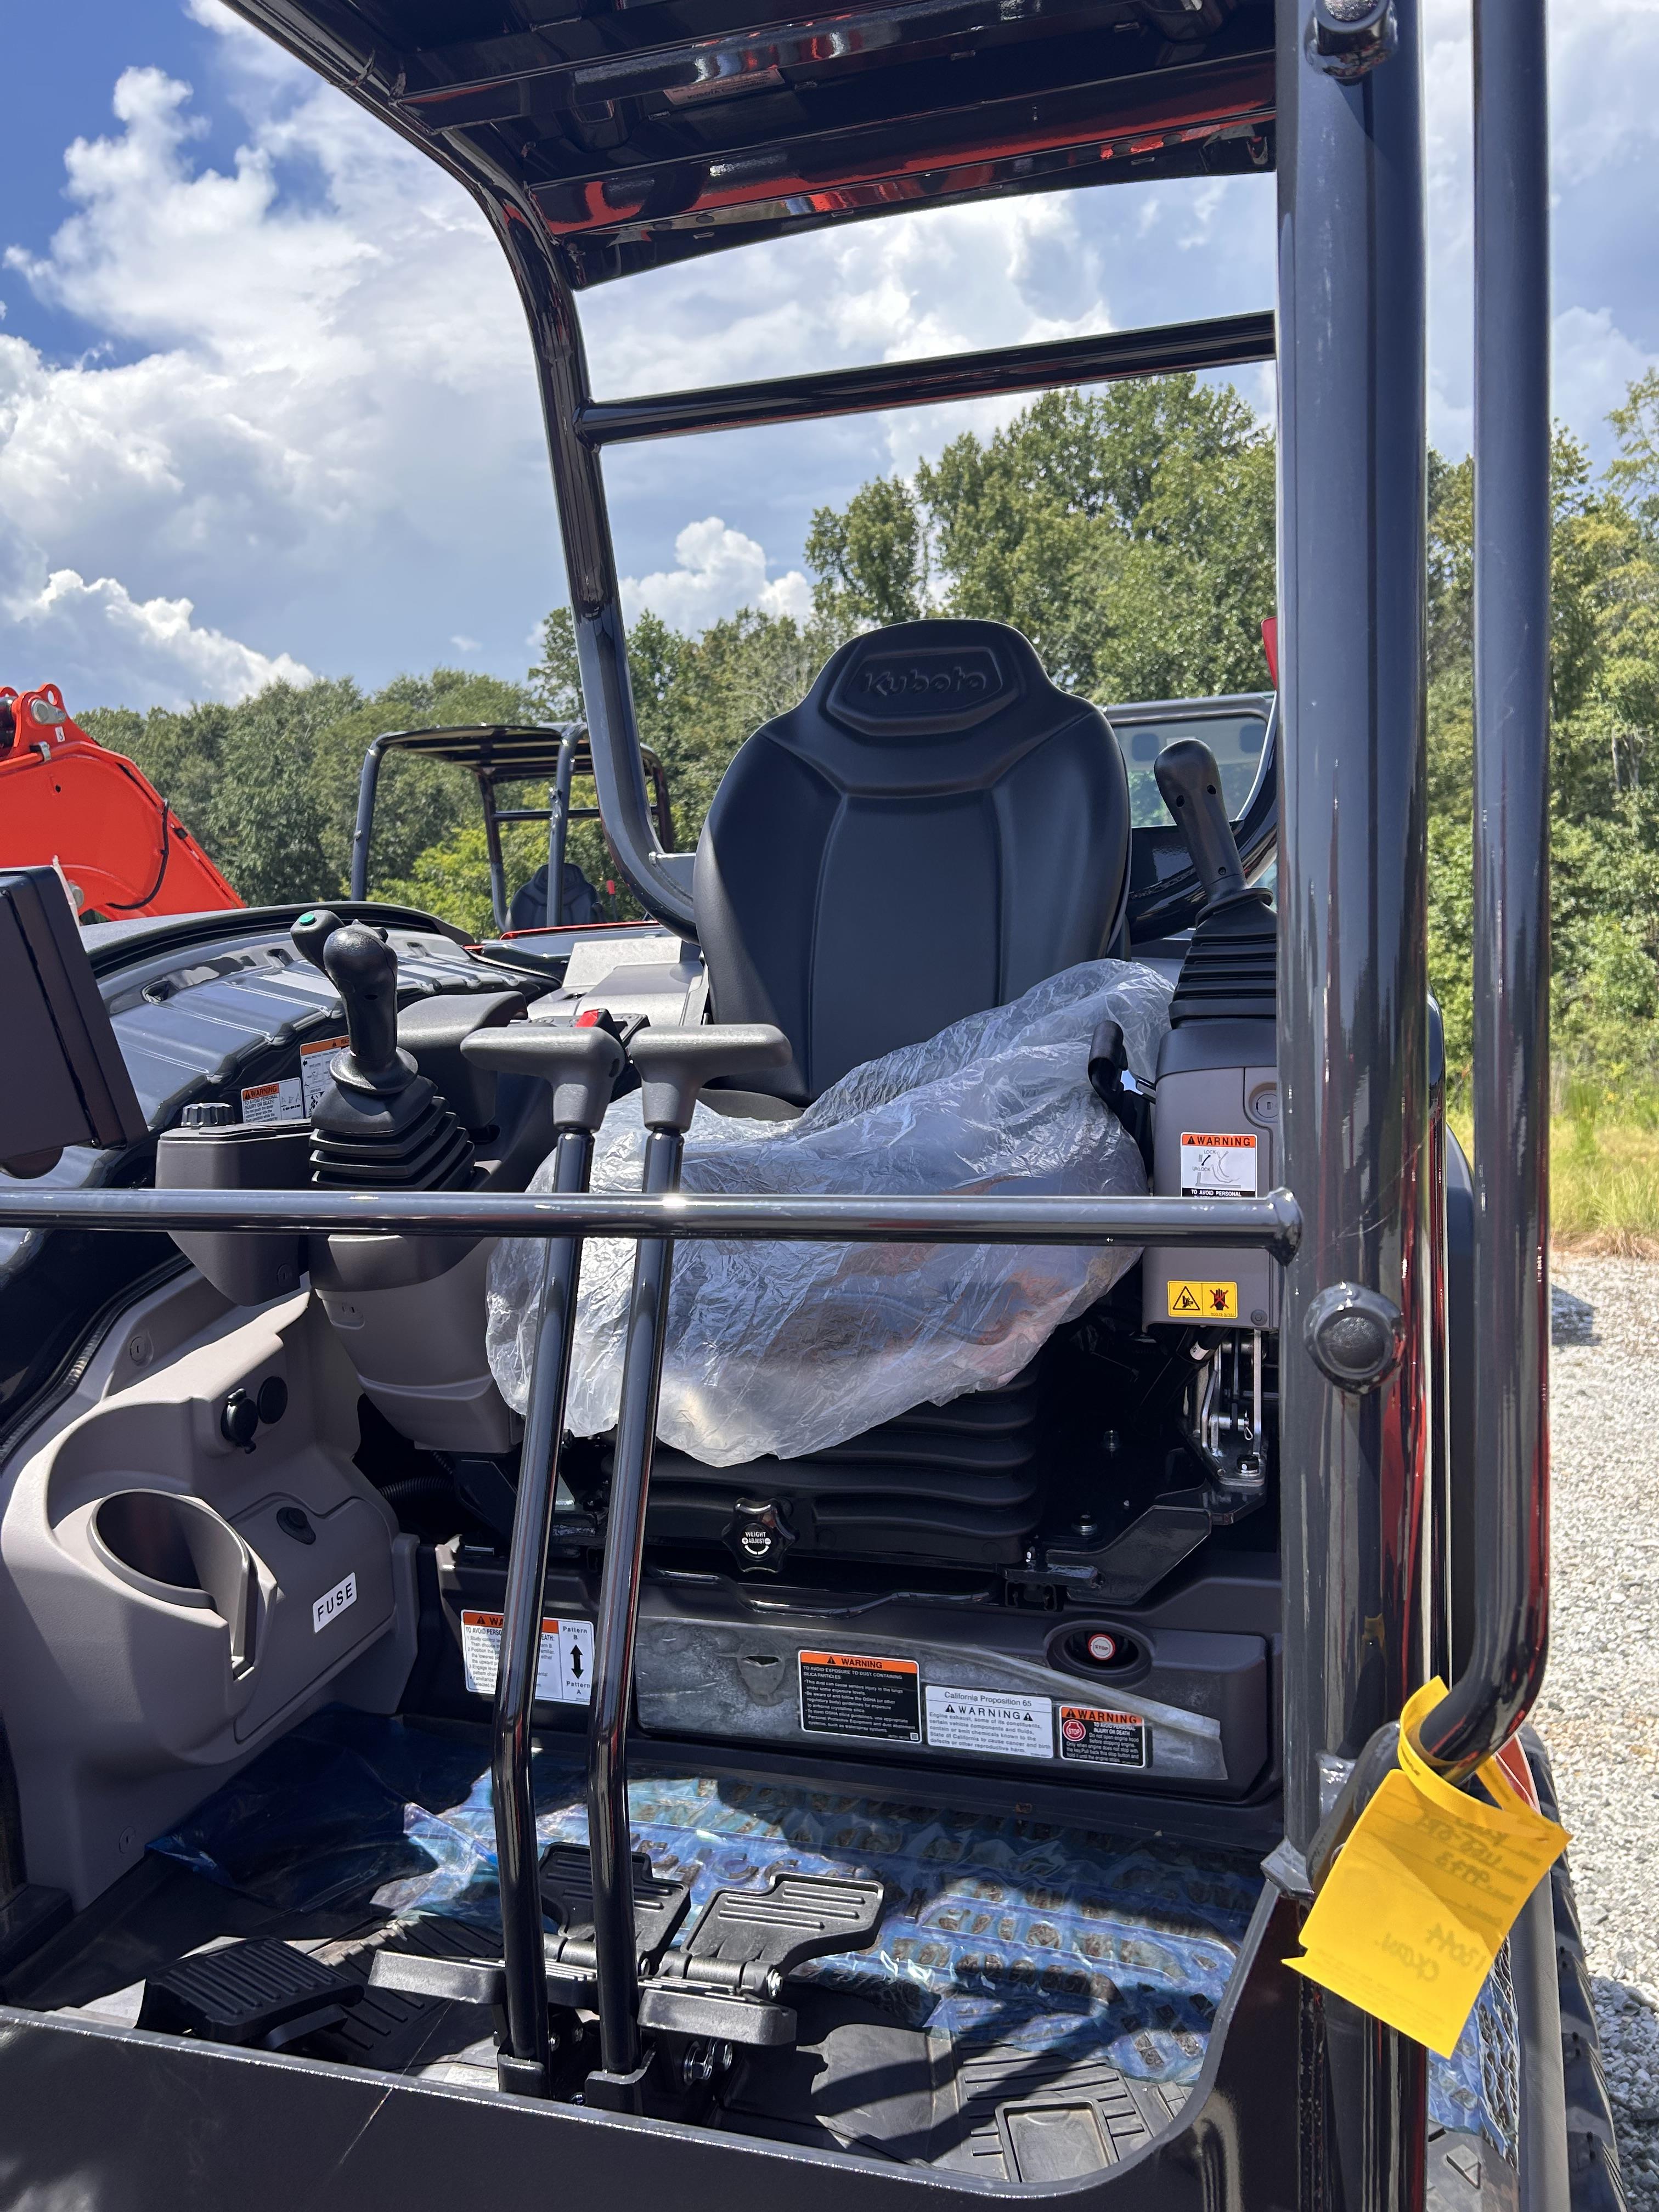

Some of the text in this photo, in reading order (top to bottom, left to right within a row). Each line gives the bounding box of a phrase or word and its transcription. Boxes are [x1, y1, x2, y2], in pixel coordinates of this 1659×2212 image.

[862, 665, 987, 696] Kubota
[251, 1085, 277, 1097] WARNING
[1197, 1136, 1250, 1147] WARNING
[318, 1582, 353, 1622] FUSE
[563, 1626, 588, 1634] Pattern
[840, 1657, 882, 1668] WARNING
[566, 1680, 591, 1689] Pattern
[944, 1691, 978, 1701] California
[980, 1695, 1020, 1706] Proposition
[958, 1705, 1020, 1719] WARNING
[1077, 1709, 1137, 1723] WARNING
[970, 1723, 1003, 1731] components
[1006, 1721, 1041, 1729] constituents,
